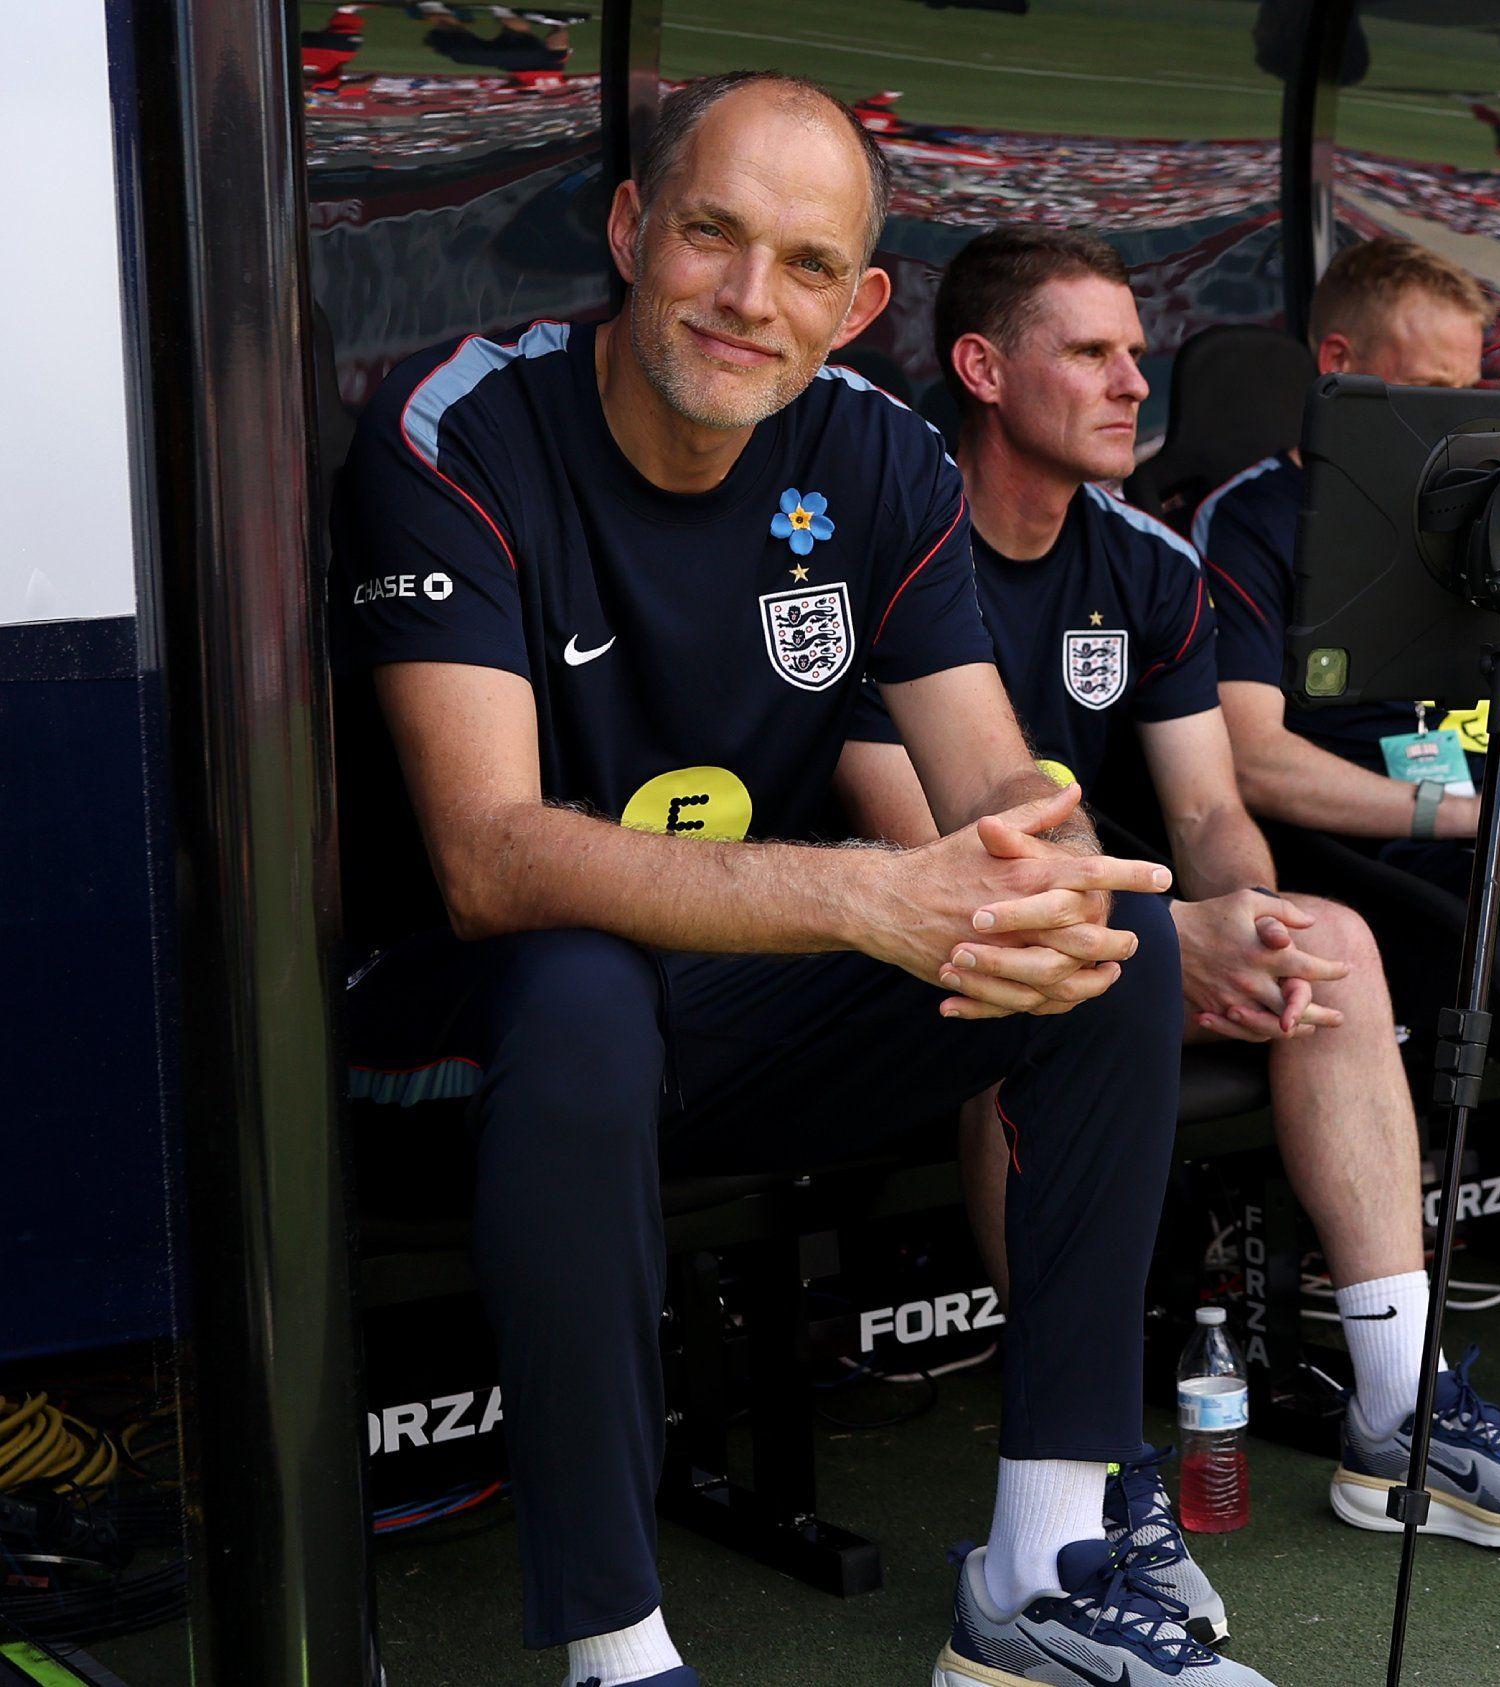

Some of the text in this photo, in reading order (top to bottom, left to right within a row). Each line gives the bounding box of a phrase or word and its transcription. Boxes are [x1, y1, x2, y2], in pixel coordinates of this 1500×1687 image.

[354, 574, 417, 604] CHASE
[860, 1286, 1006, 1352] FORZ
[1245, 1204, 1271, 1368] FORZA
